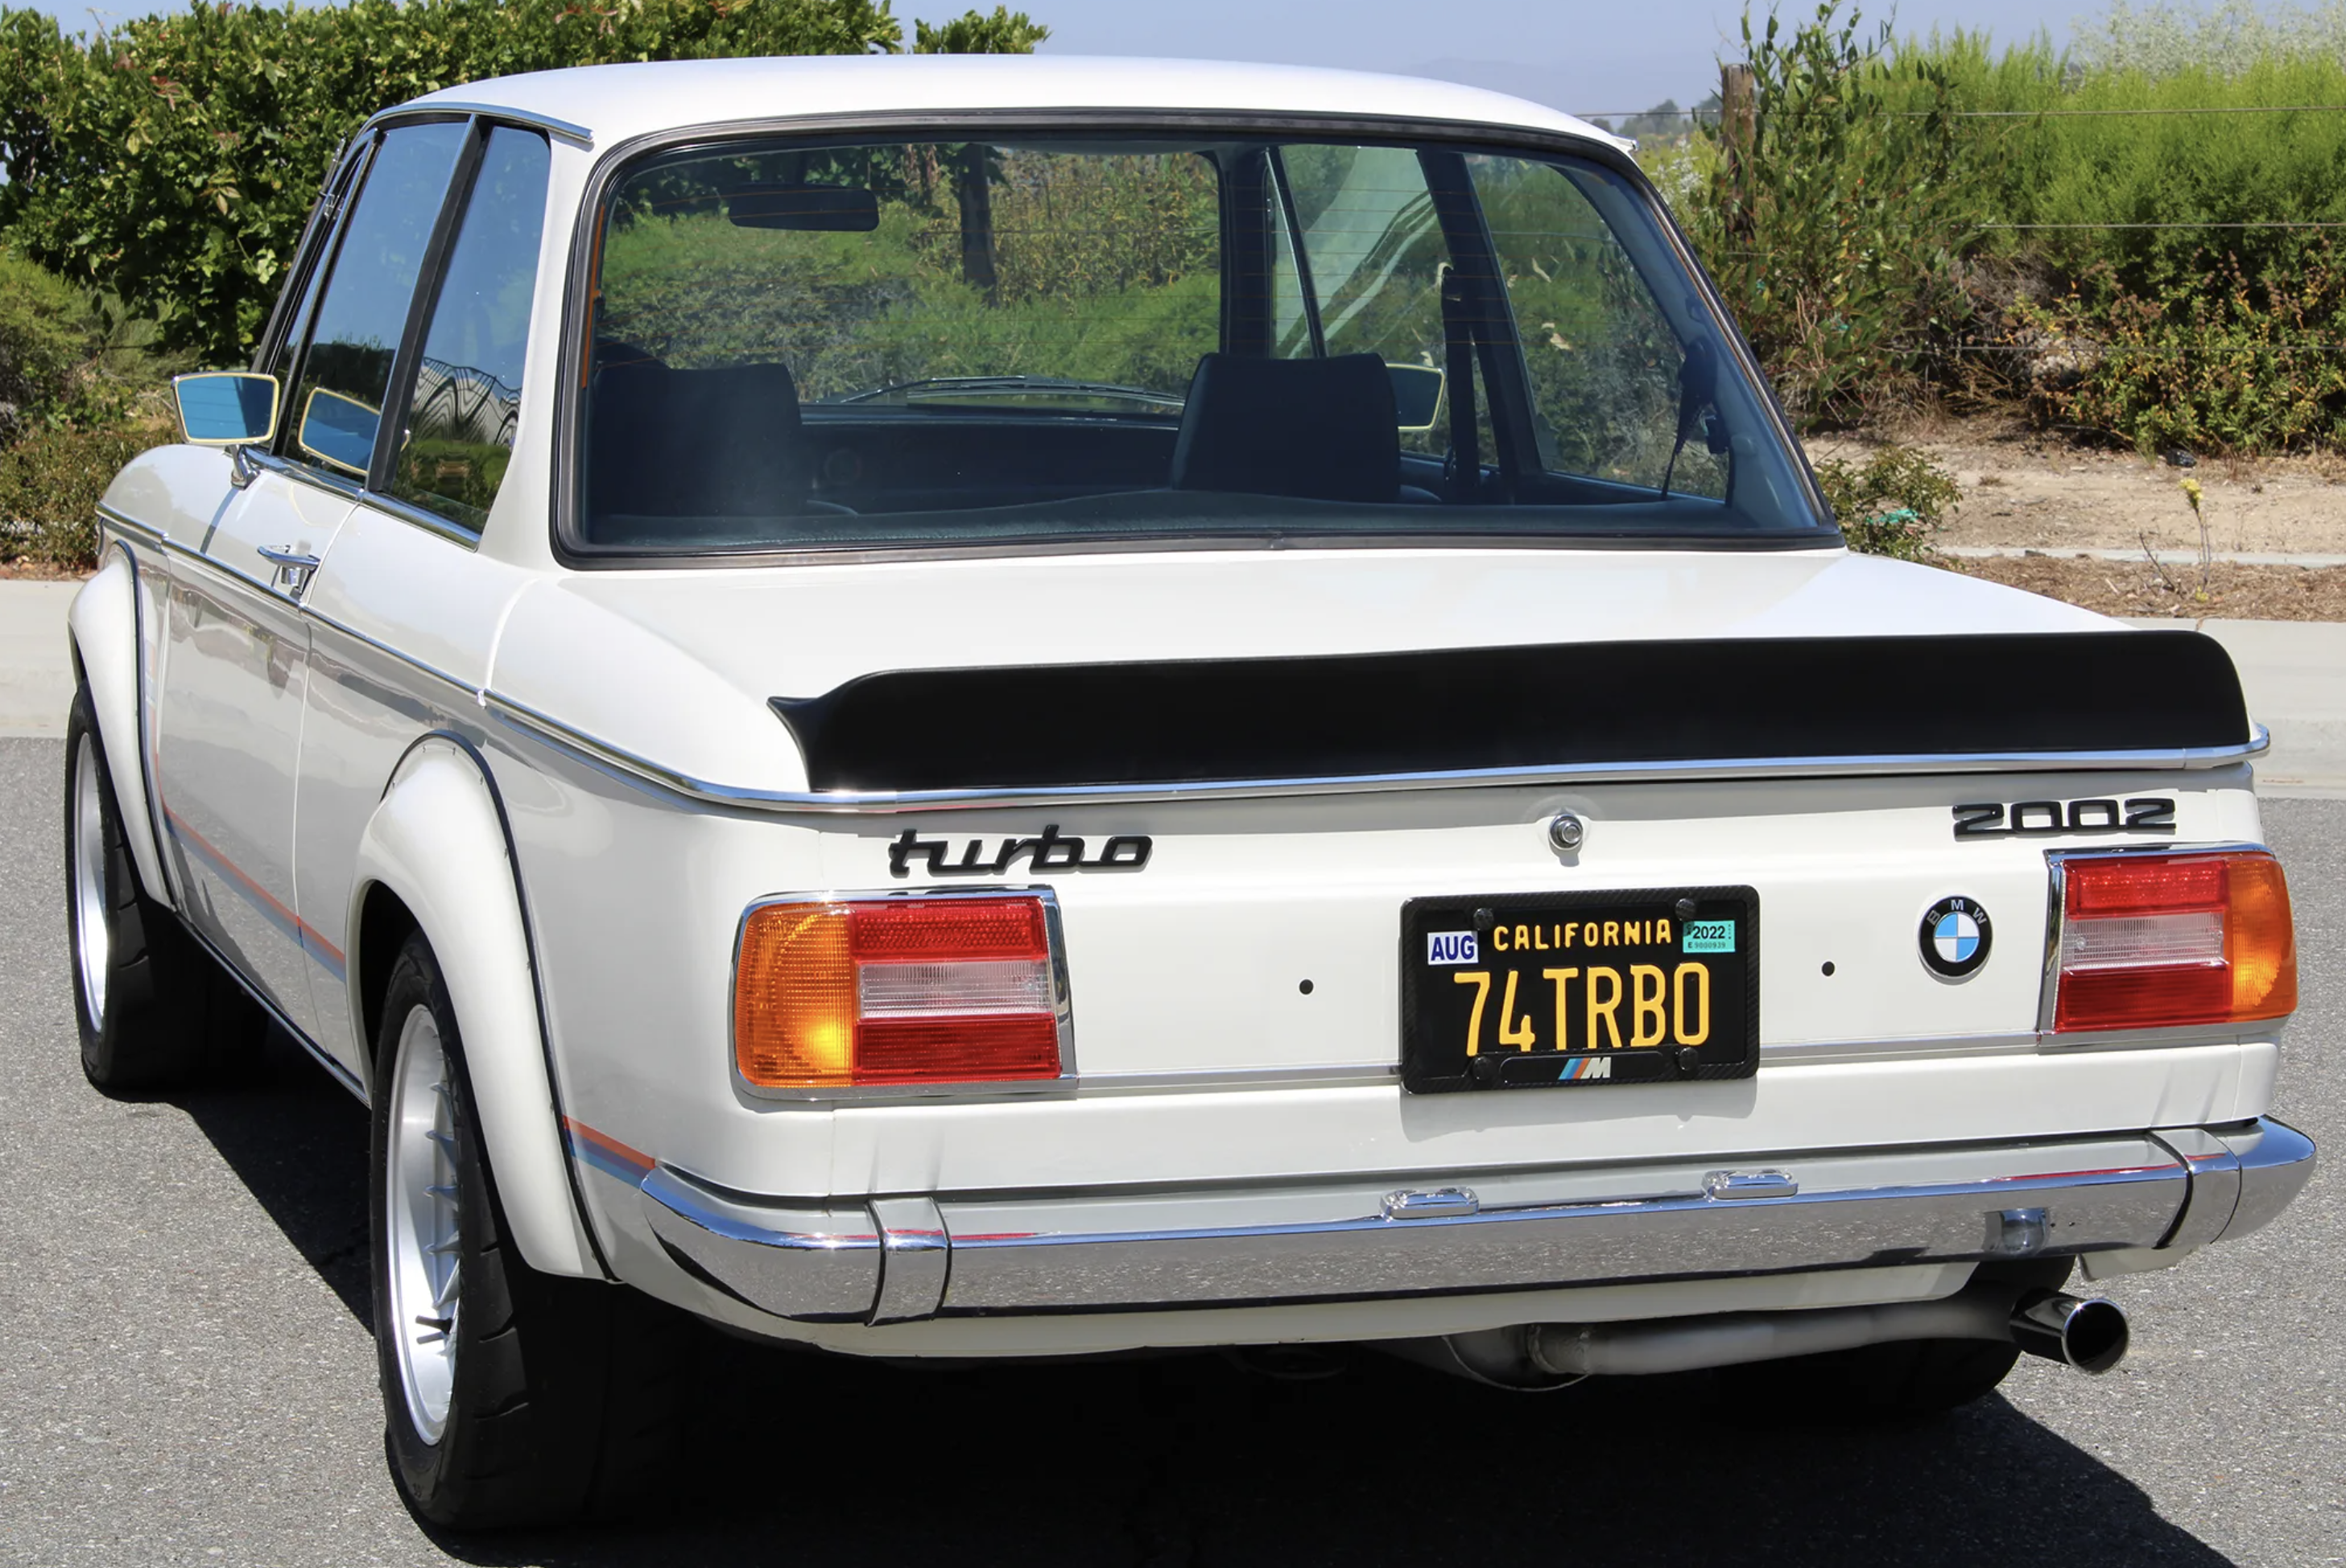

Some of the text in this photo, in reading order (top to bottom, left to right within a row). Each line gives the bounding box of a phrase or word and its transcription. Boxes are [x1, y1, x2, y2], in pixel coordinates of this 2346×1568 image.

[1952, 798, 2176, 840] 2002
[889, 824, 1153, 877] turbo
[1926, 899, 1987, 926] BMW
[1493, 918, 1671, 951] CALIFORNIA
[1692, 926, 1725, 939] 2022
[1431, 935, 1474, 961] AUG
[1454, 962, 1709, 1057] 74TRBO
[1580, 1057, 1611, 1079] M
